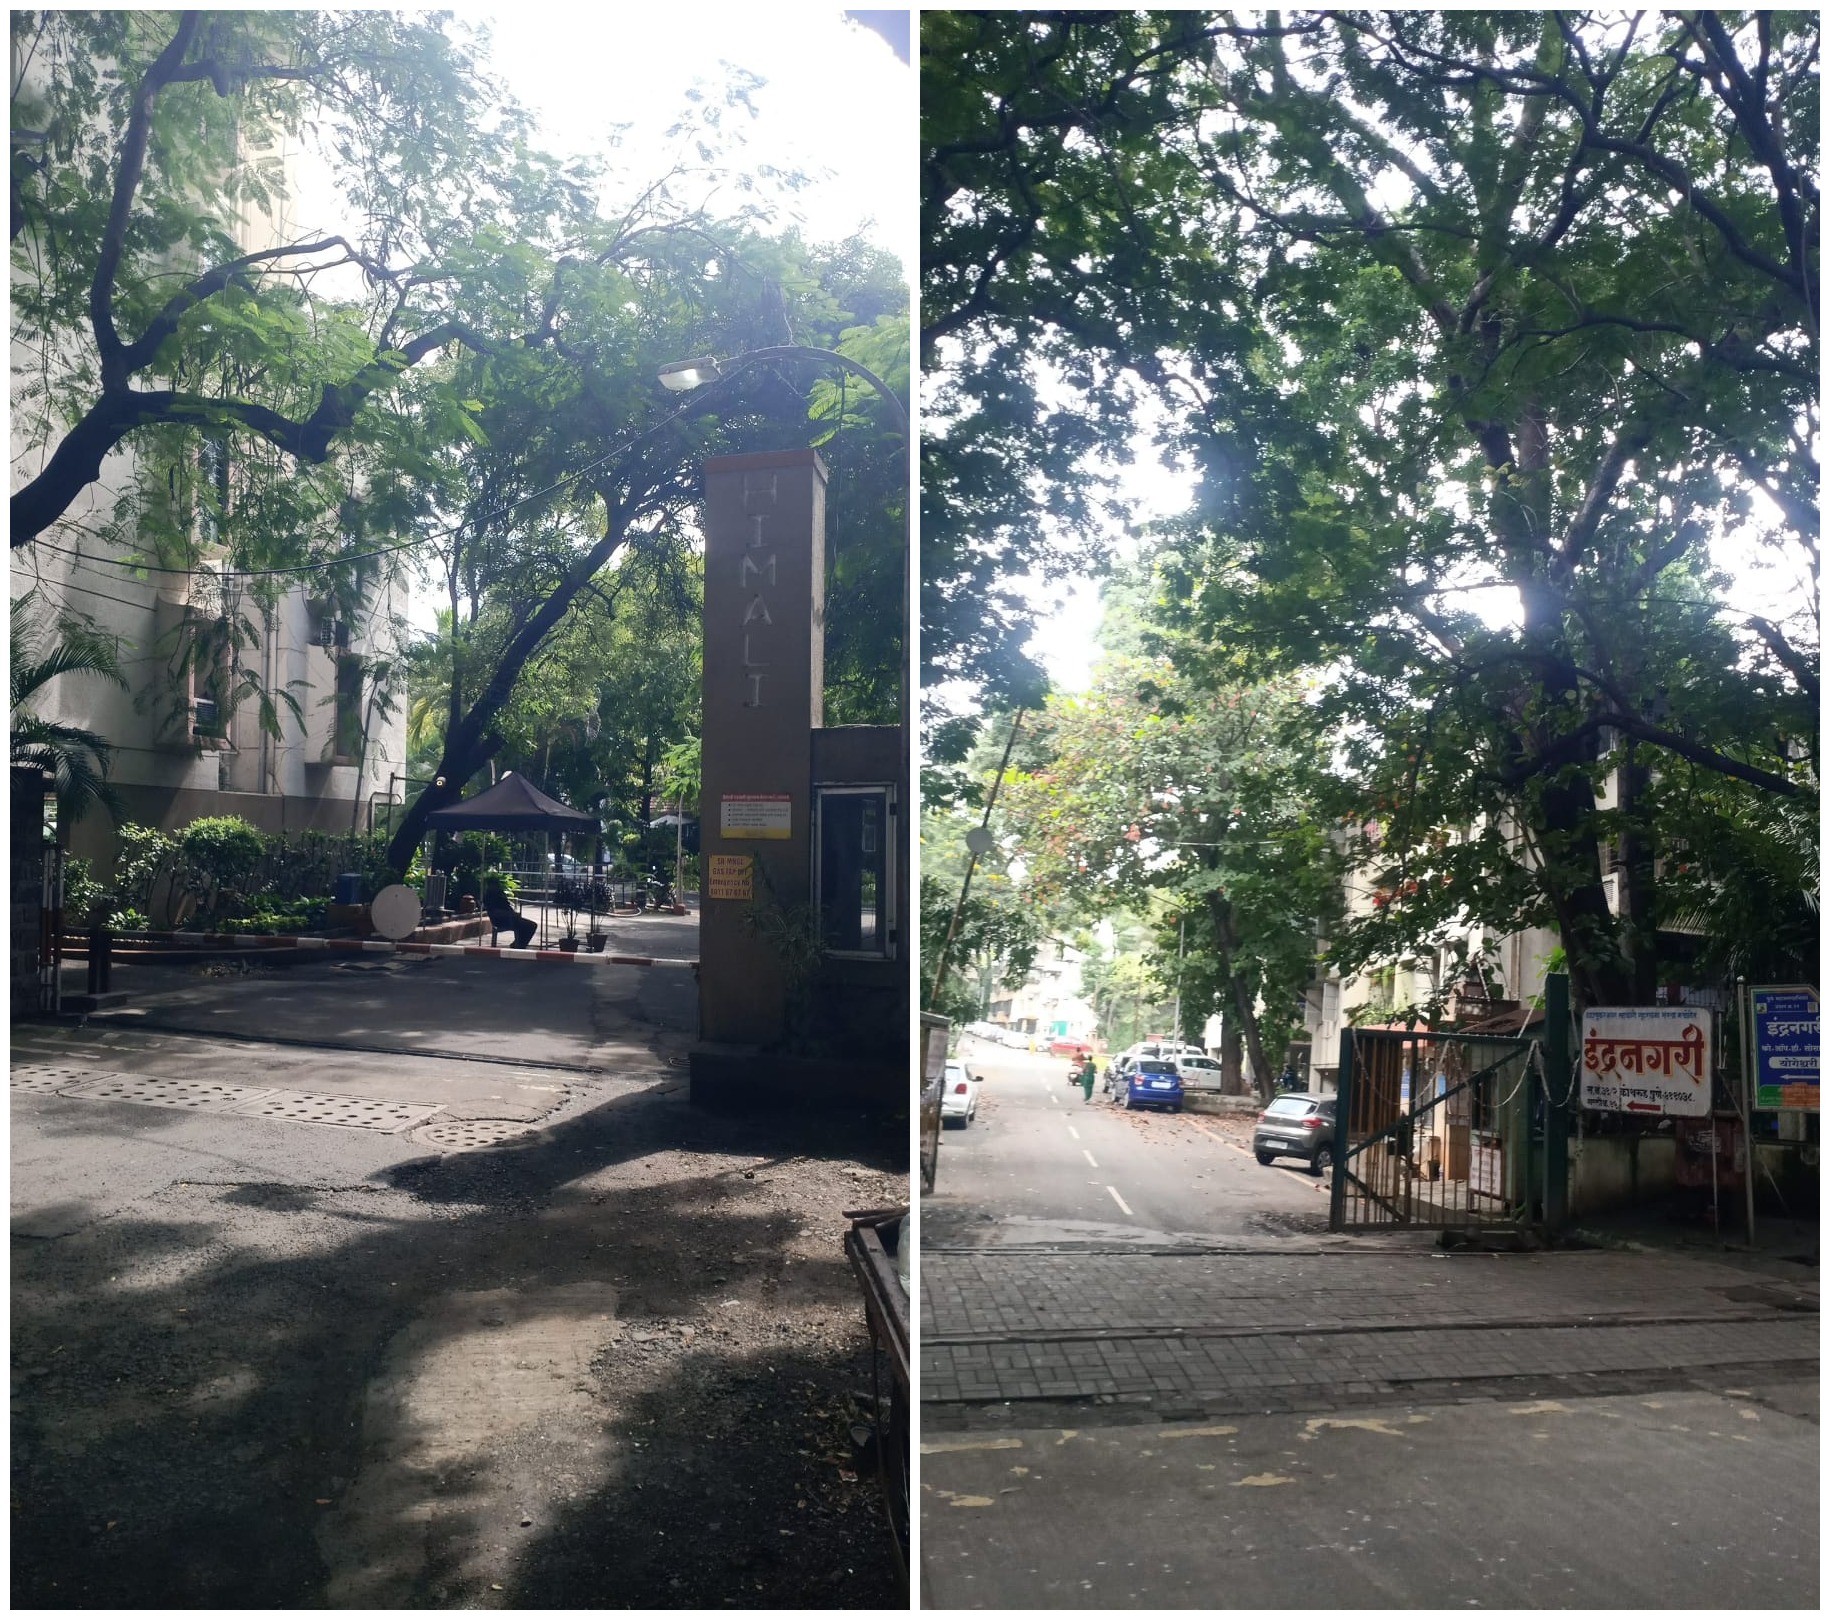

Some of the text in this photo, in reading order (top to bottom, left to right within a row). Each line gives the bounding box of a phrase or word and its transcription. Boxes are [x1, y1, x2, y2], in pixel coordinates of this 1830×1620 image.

[740, 473, 777, 707] HIMALI
[1584, 1023, 1706, 1085] इंद्रनगरी
[1779, 1057, 1818, 1068] योगेश्वरी
